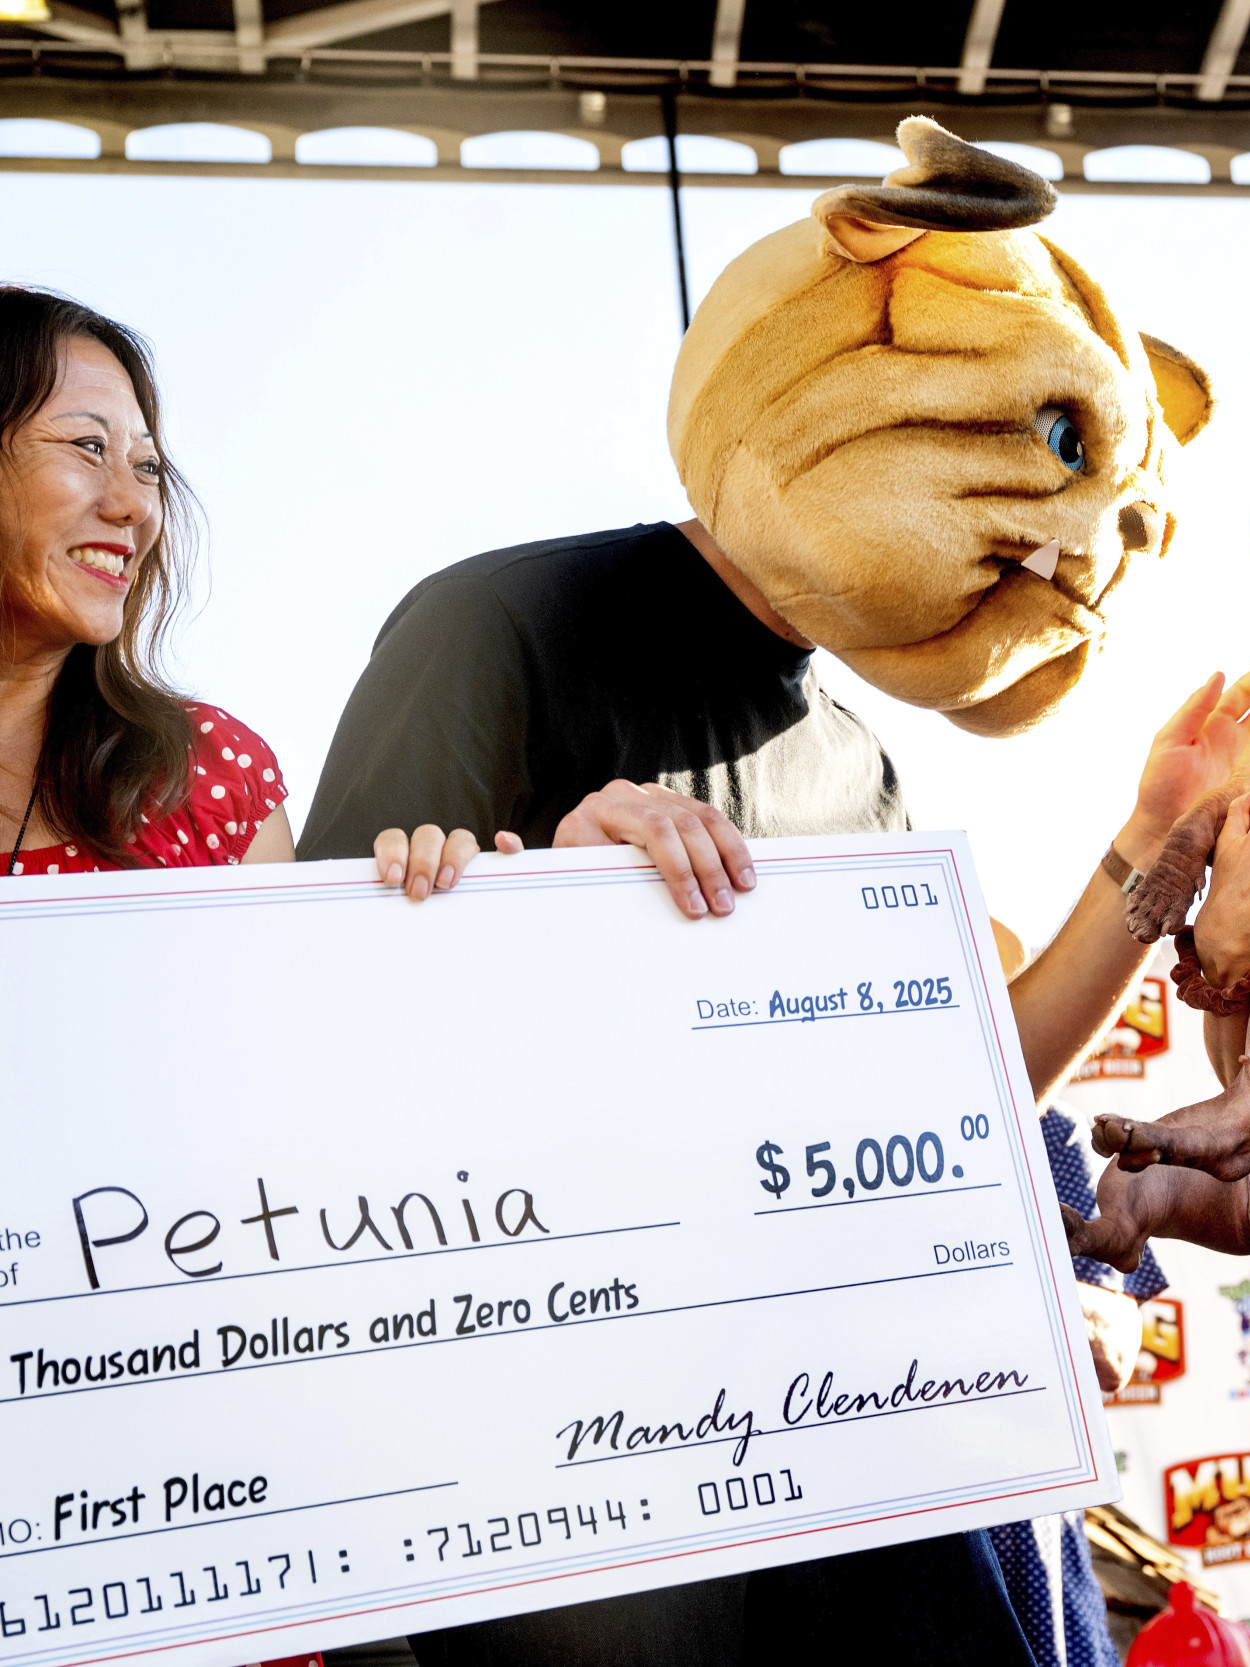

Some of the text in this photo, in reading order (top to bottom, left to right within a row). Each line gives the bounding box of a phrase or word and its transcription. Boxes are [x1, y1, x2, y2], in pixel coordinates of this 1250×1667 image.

[861, 883, 939, 910] 0001
[696, 976, 953, 1024] Date: August 8, 2025
[72, 1170, 551, 1291] Petunia
[933, 1237, 1011, 1266] Dollars
[10, 1277, 640, 1395] Thousand Dollars and Zero Cents
[556, 1358, 1029, 1467] Mandy Clendenen
[54, 1485, 147, 1542] First
[162, 1472, 269, 1524] Place
[697, 1468, 804, 1517] 0001
